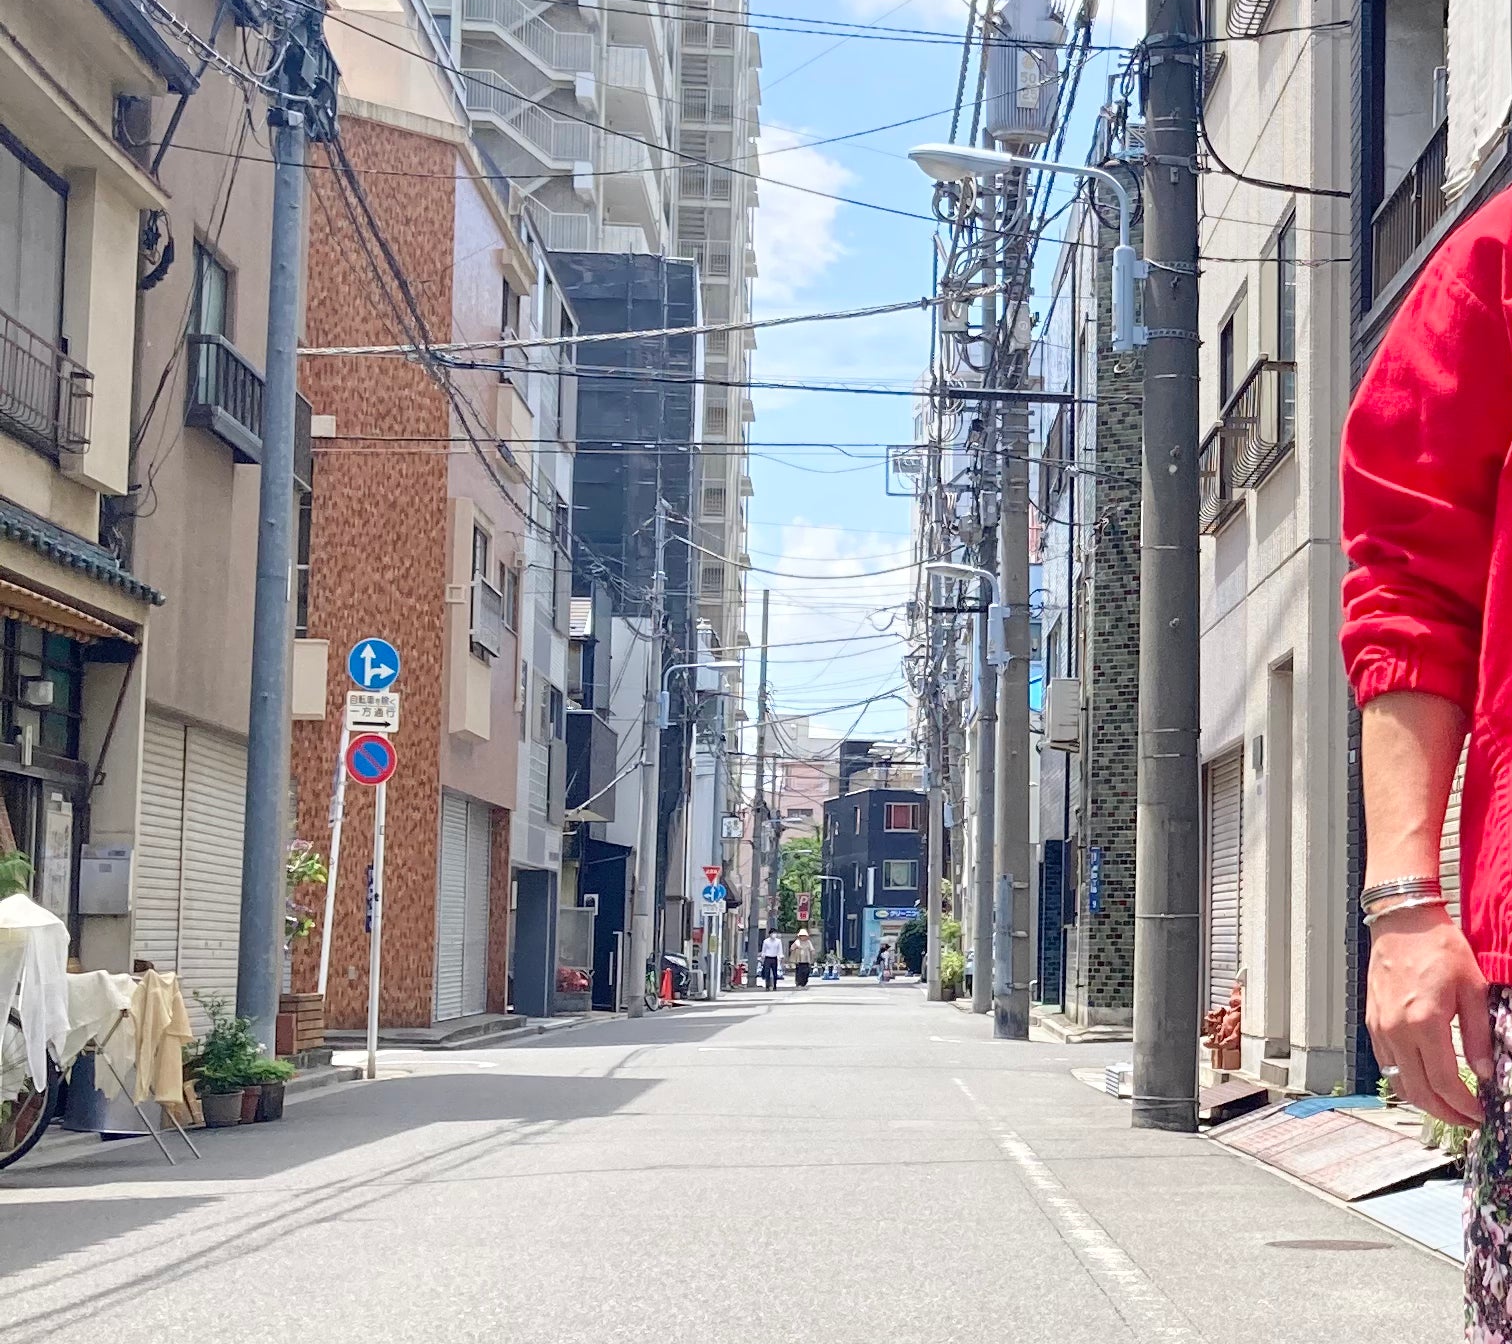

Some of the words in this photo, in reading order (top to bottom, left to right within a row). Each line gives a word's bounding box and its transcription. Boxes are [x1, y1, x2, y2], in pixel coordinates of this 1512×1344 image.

[350, 695, 396, 705] 自転車を除く
[349, 707, 396, 718] 一方通行
